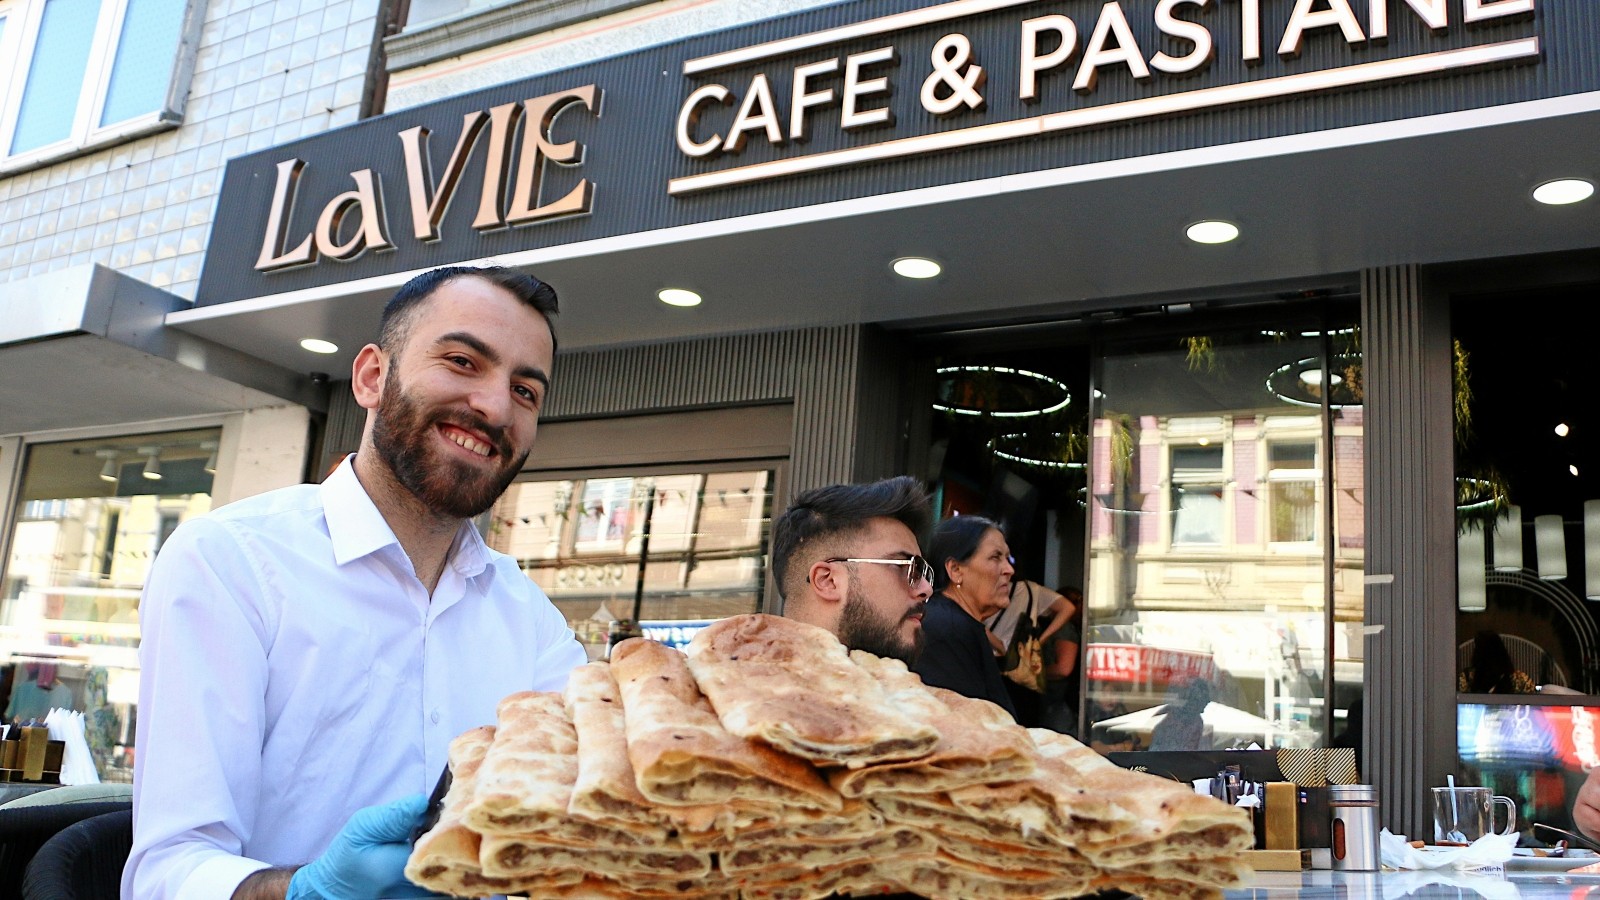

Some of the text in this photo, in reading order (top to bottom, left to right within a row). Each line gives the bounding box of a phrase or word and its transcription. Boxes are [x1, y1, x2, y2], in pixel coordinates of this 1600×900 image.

[675, 0, 1535, 158] CAFE & PASTA
[254, 157, 396, 273] La
